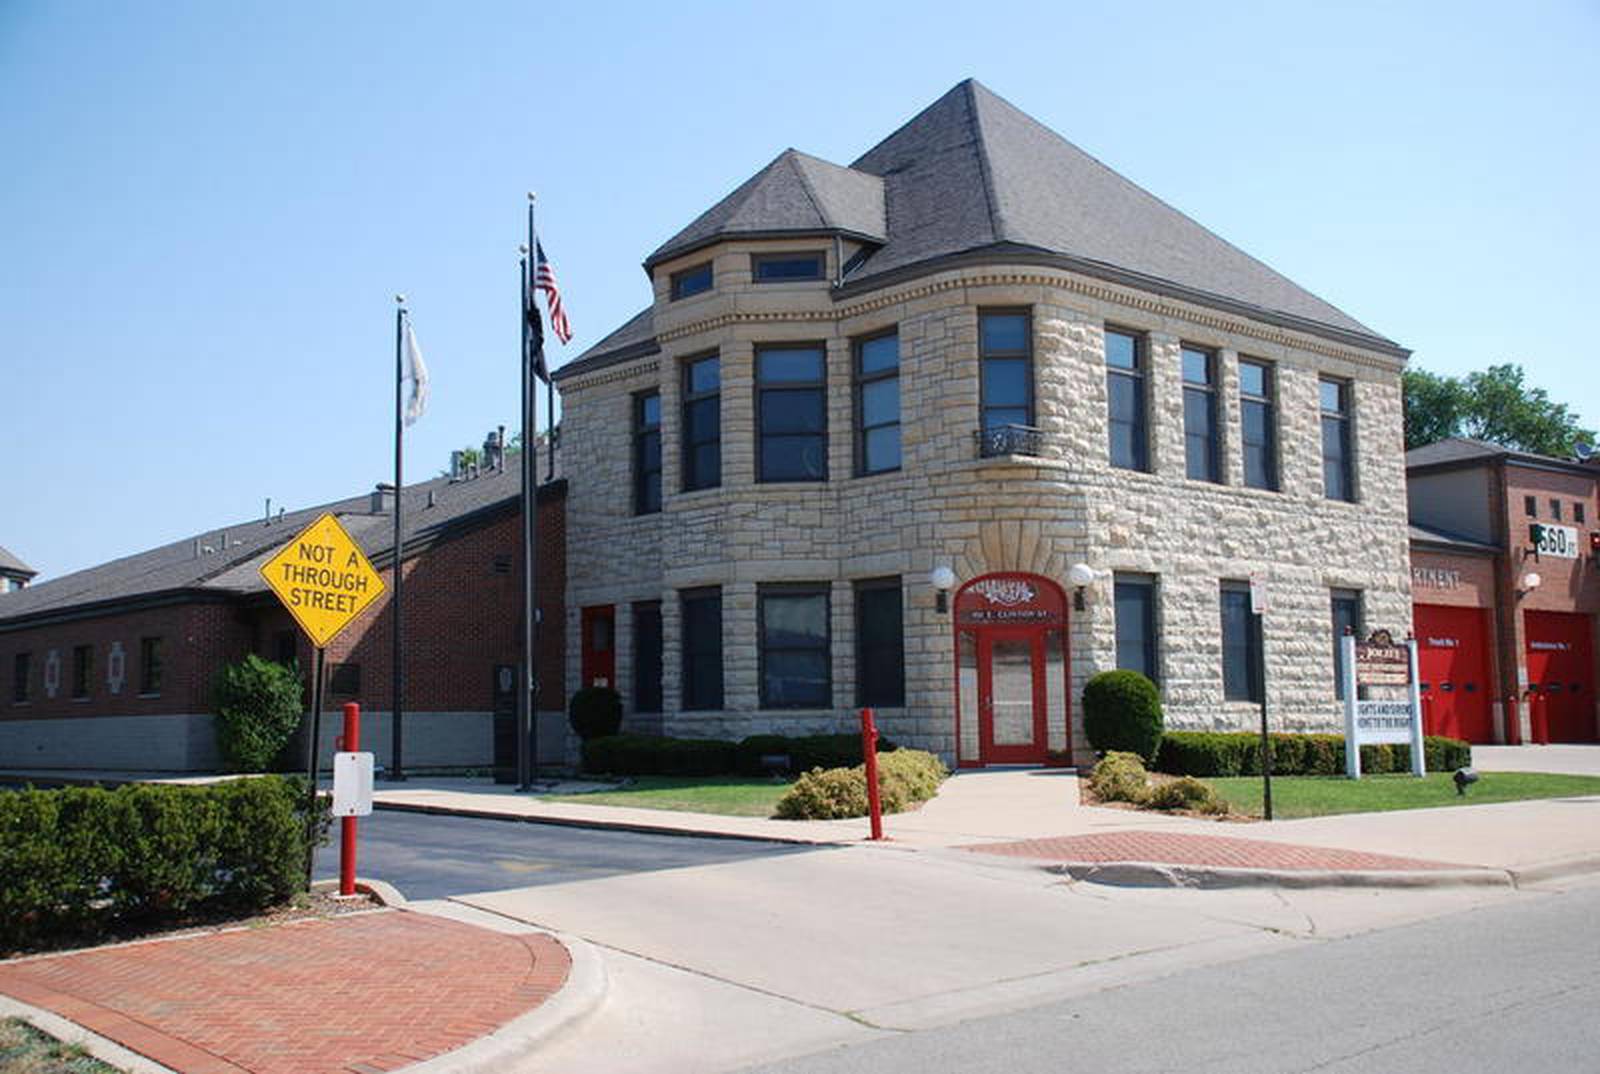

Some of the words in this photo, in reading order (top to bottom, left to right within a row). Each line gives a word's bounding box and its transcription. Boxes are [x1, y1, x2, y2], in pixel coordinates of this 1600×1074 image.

[299, 543, 335, 563] NOT
[346, 551, 359, 568] A
[282, 563, 368, 593] THROUGH
[290, 587, 358, 613] STREET
